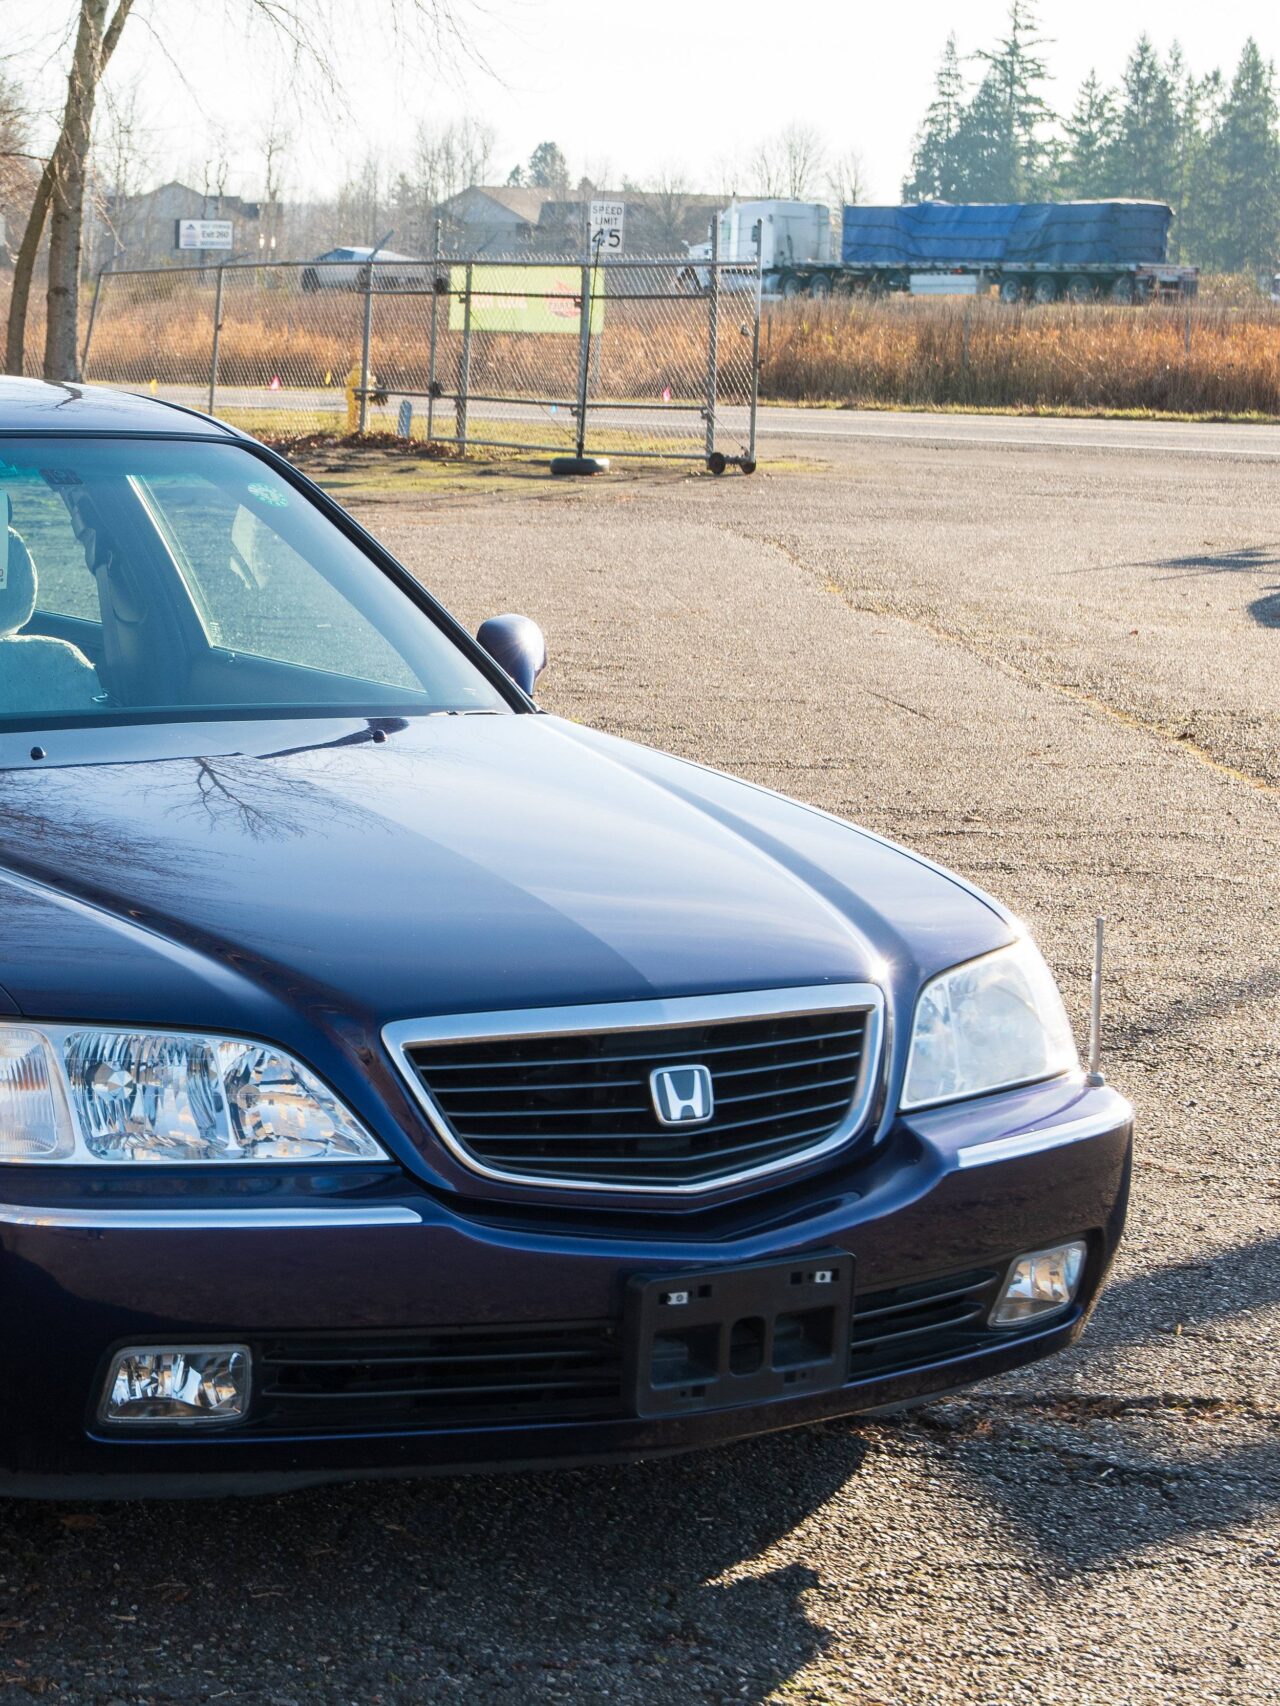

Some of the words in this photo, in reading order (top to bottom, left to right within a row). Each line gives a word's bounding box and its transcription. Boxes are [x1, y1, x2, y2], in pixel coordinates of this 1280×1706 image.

[592, 205, 622, 215] SPEED
[595, 216, 618, 225] LIMIT
[592, 228, 620, 247] 45
